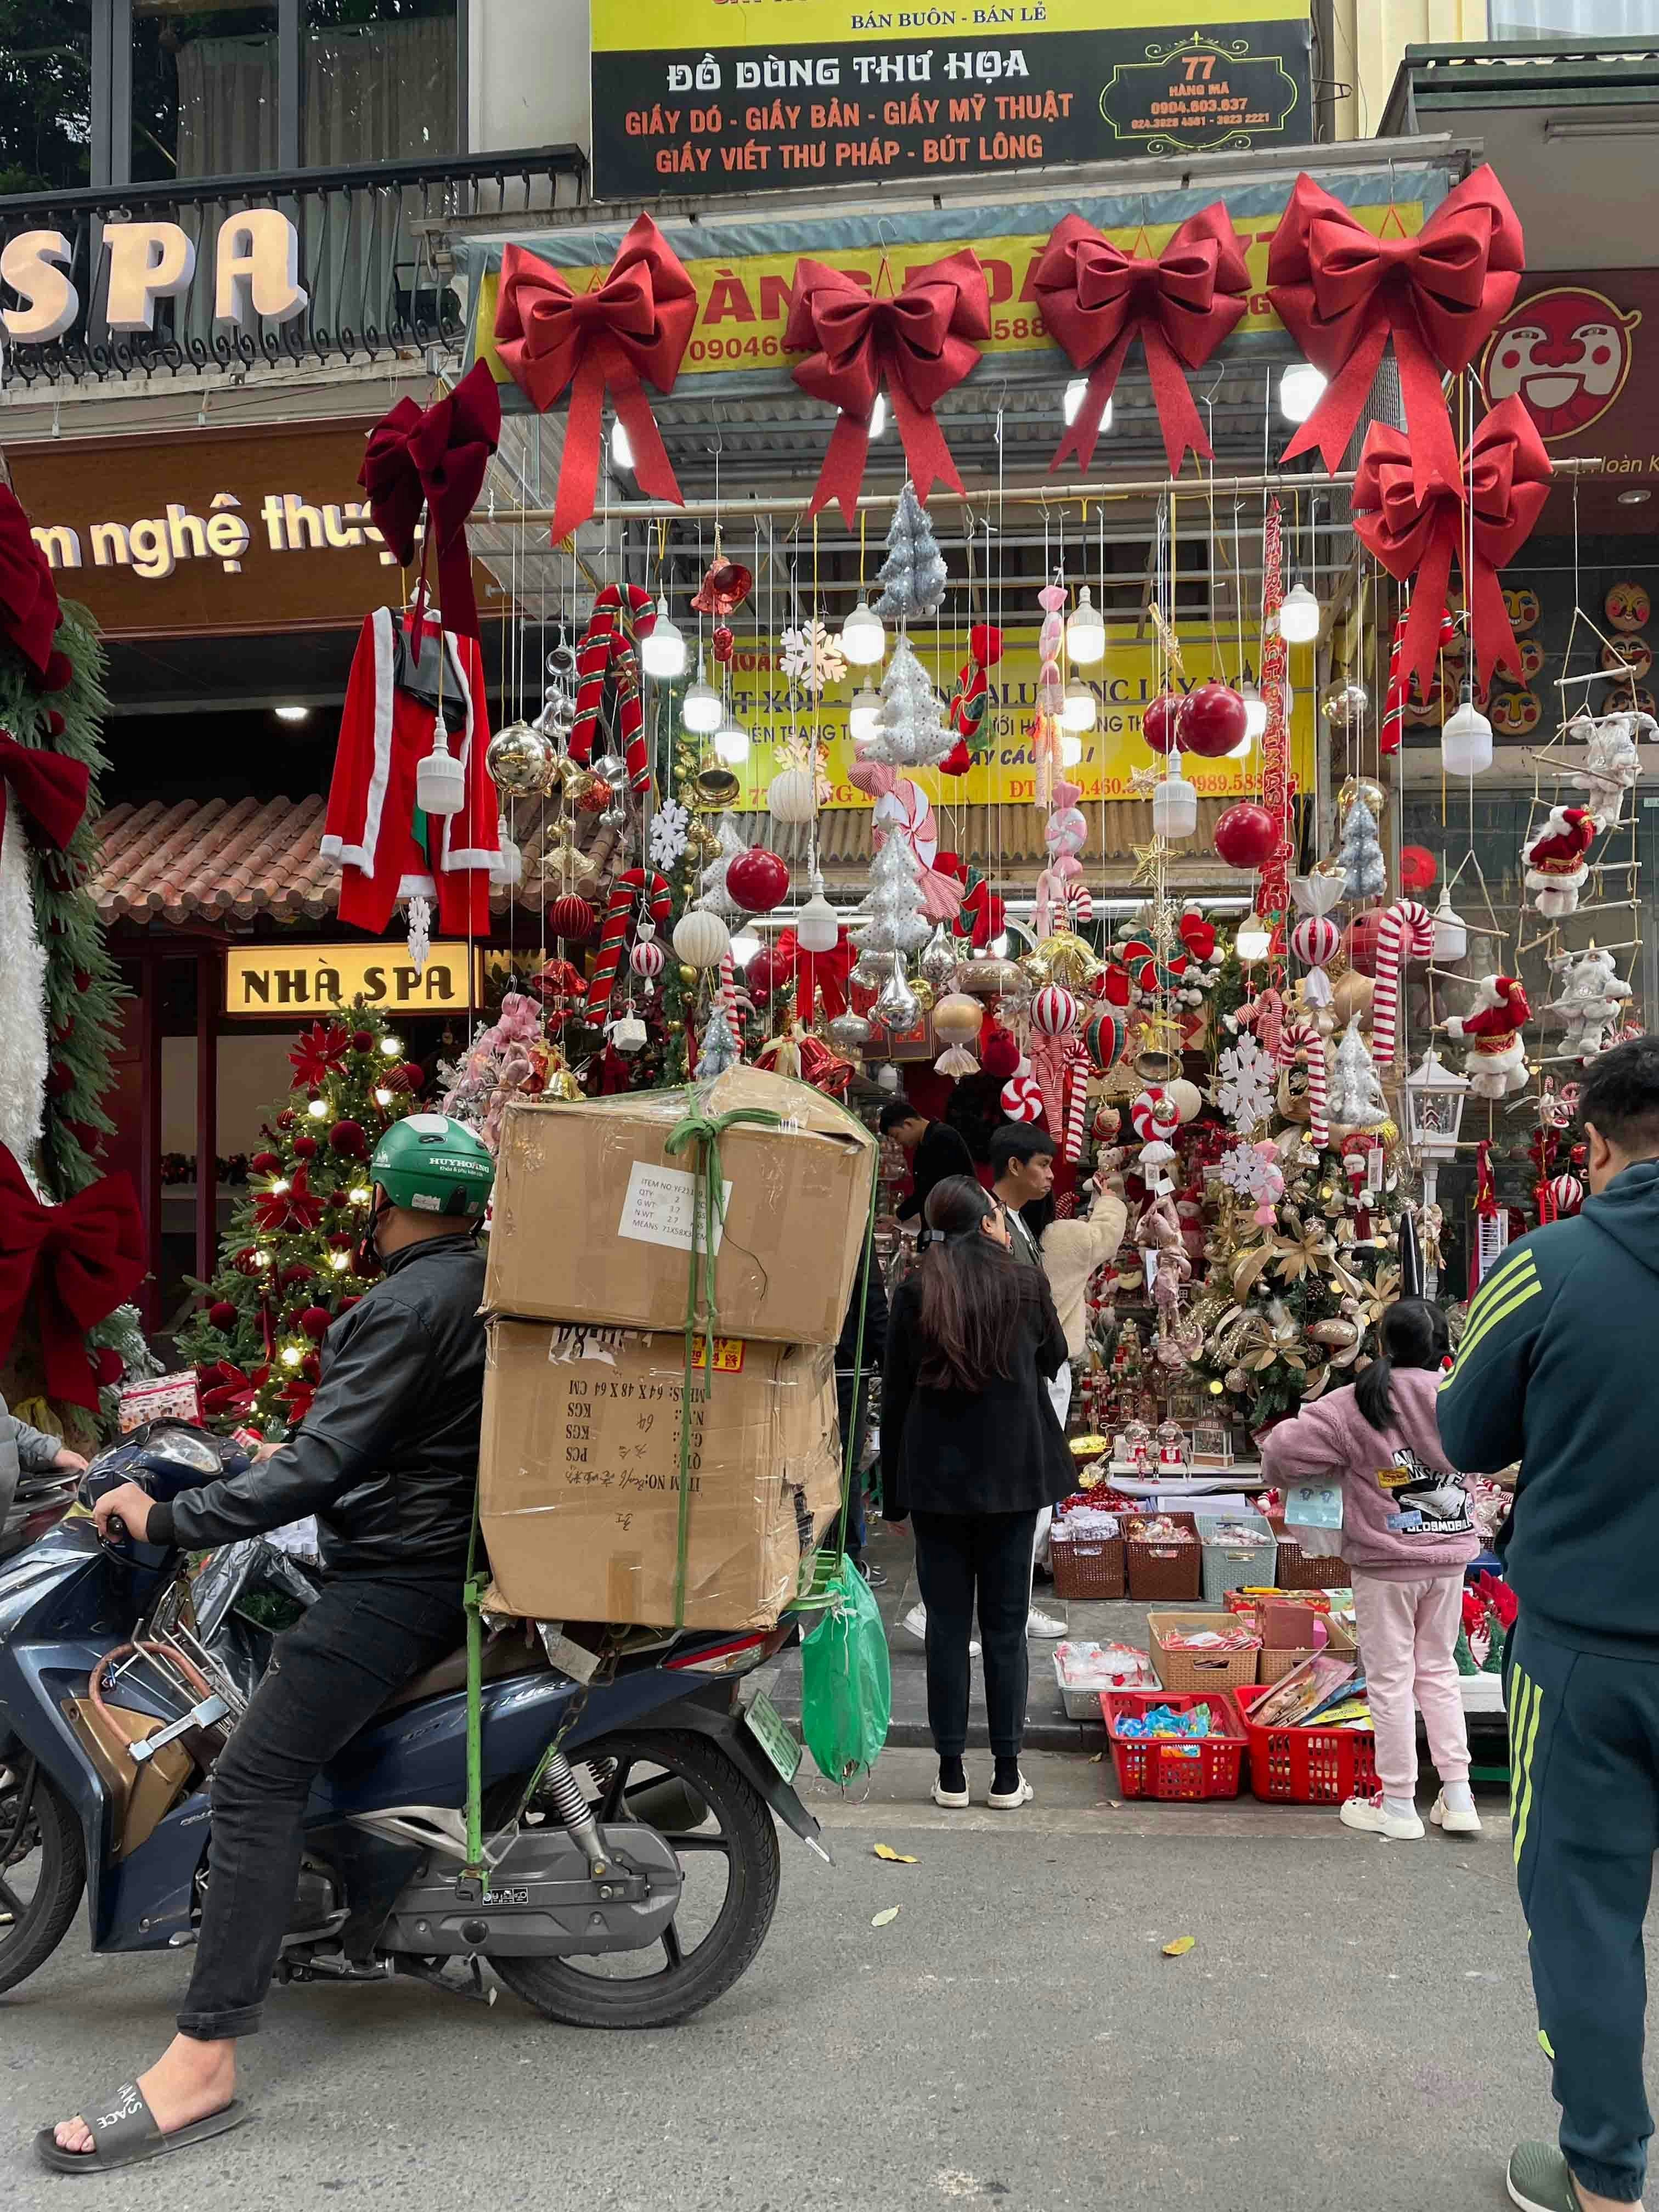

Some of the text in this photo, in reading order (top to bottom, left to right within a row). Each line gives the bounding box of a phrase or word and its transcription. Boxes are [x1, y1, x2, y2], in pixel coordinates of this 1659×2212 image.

[851, 11, 891, 29] BÁN
[898, 8, 955, 27] BUÔN
[973, 5, 1014, 23] BÁN
[1020, 1, 1047, 21] LẺ
[667, 49, 1030, 91] ĐỒ DÙNG THƯ HỌA
[1182, 55, 1216, 80] 77
[625, 103, 681, 136] GIẤY
[690, 105, 722, 133] DÓ
[746, 98, 801, 132] GIẤY
[811, 97, 860, 128] BẢN
[883, 92, 940, 126] GIẤY
[949, 93, 986, 123] MỸ
[994, 89, 1074, 123] THUẬT
[655, 141, 712, 173] GIẤY
[720, 138, 772, 171] VIẾT
[778, 140, 826, 169] THƯ
[836, 137, 900, 167] PHÁP
[923, 134, 970, 163] BÚT
[979, 132, 1043, 161] LÔNG
[1, 208, 308, 343] SPA
[90, 493, 250, 579] nghệ
[240, 957, 456, 1003] NHÀ SPA
[641, 1178, 659, 1188] ITEM
[568, 1379, 588, 1396] CM
[595, 1381, 607, 1397] 64
[621, 1383, 634, 1398] 48
[649, 1384, 663, 1401] 64
[567, 1402, 591, 1418] KGS
[566, 1424, 590, 1440] KGS
[566, 1447, 588, 1462] PCS
[670, 1474, 701, 1492] ITM
